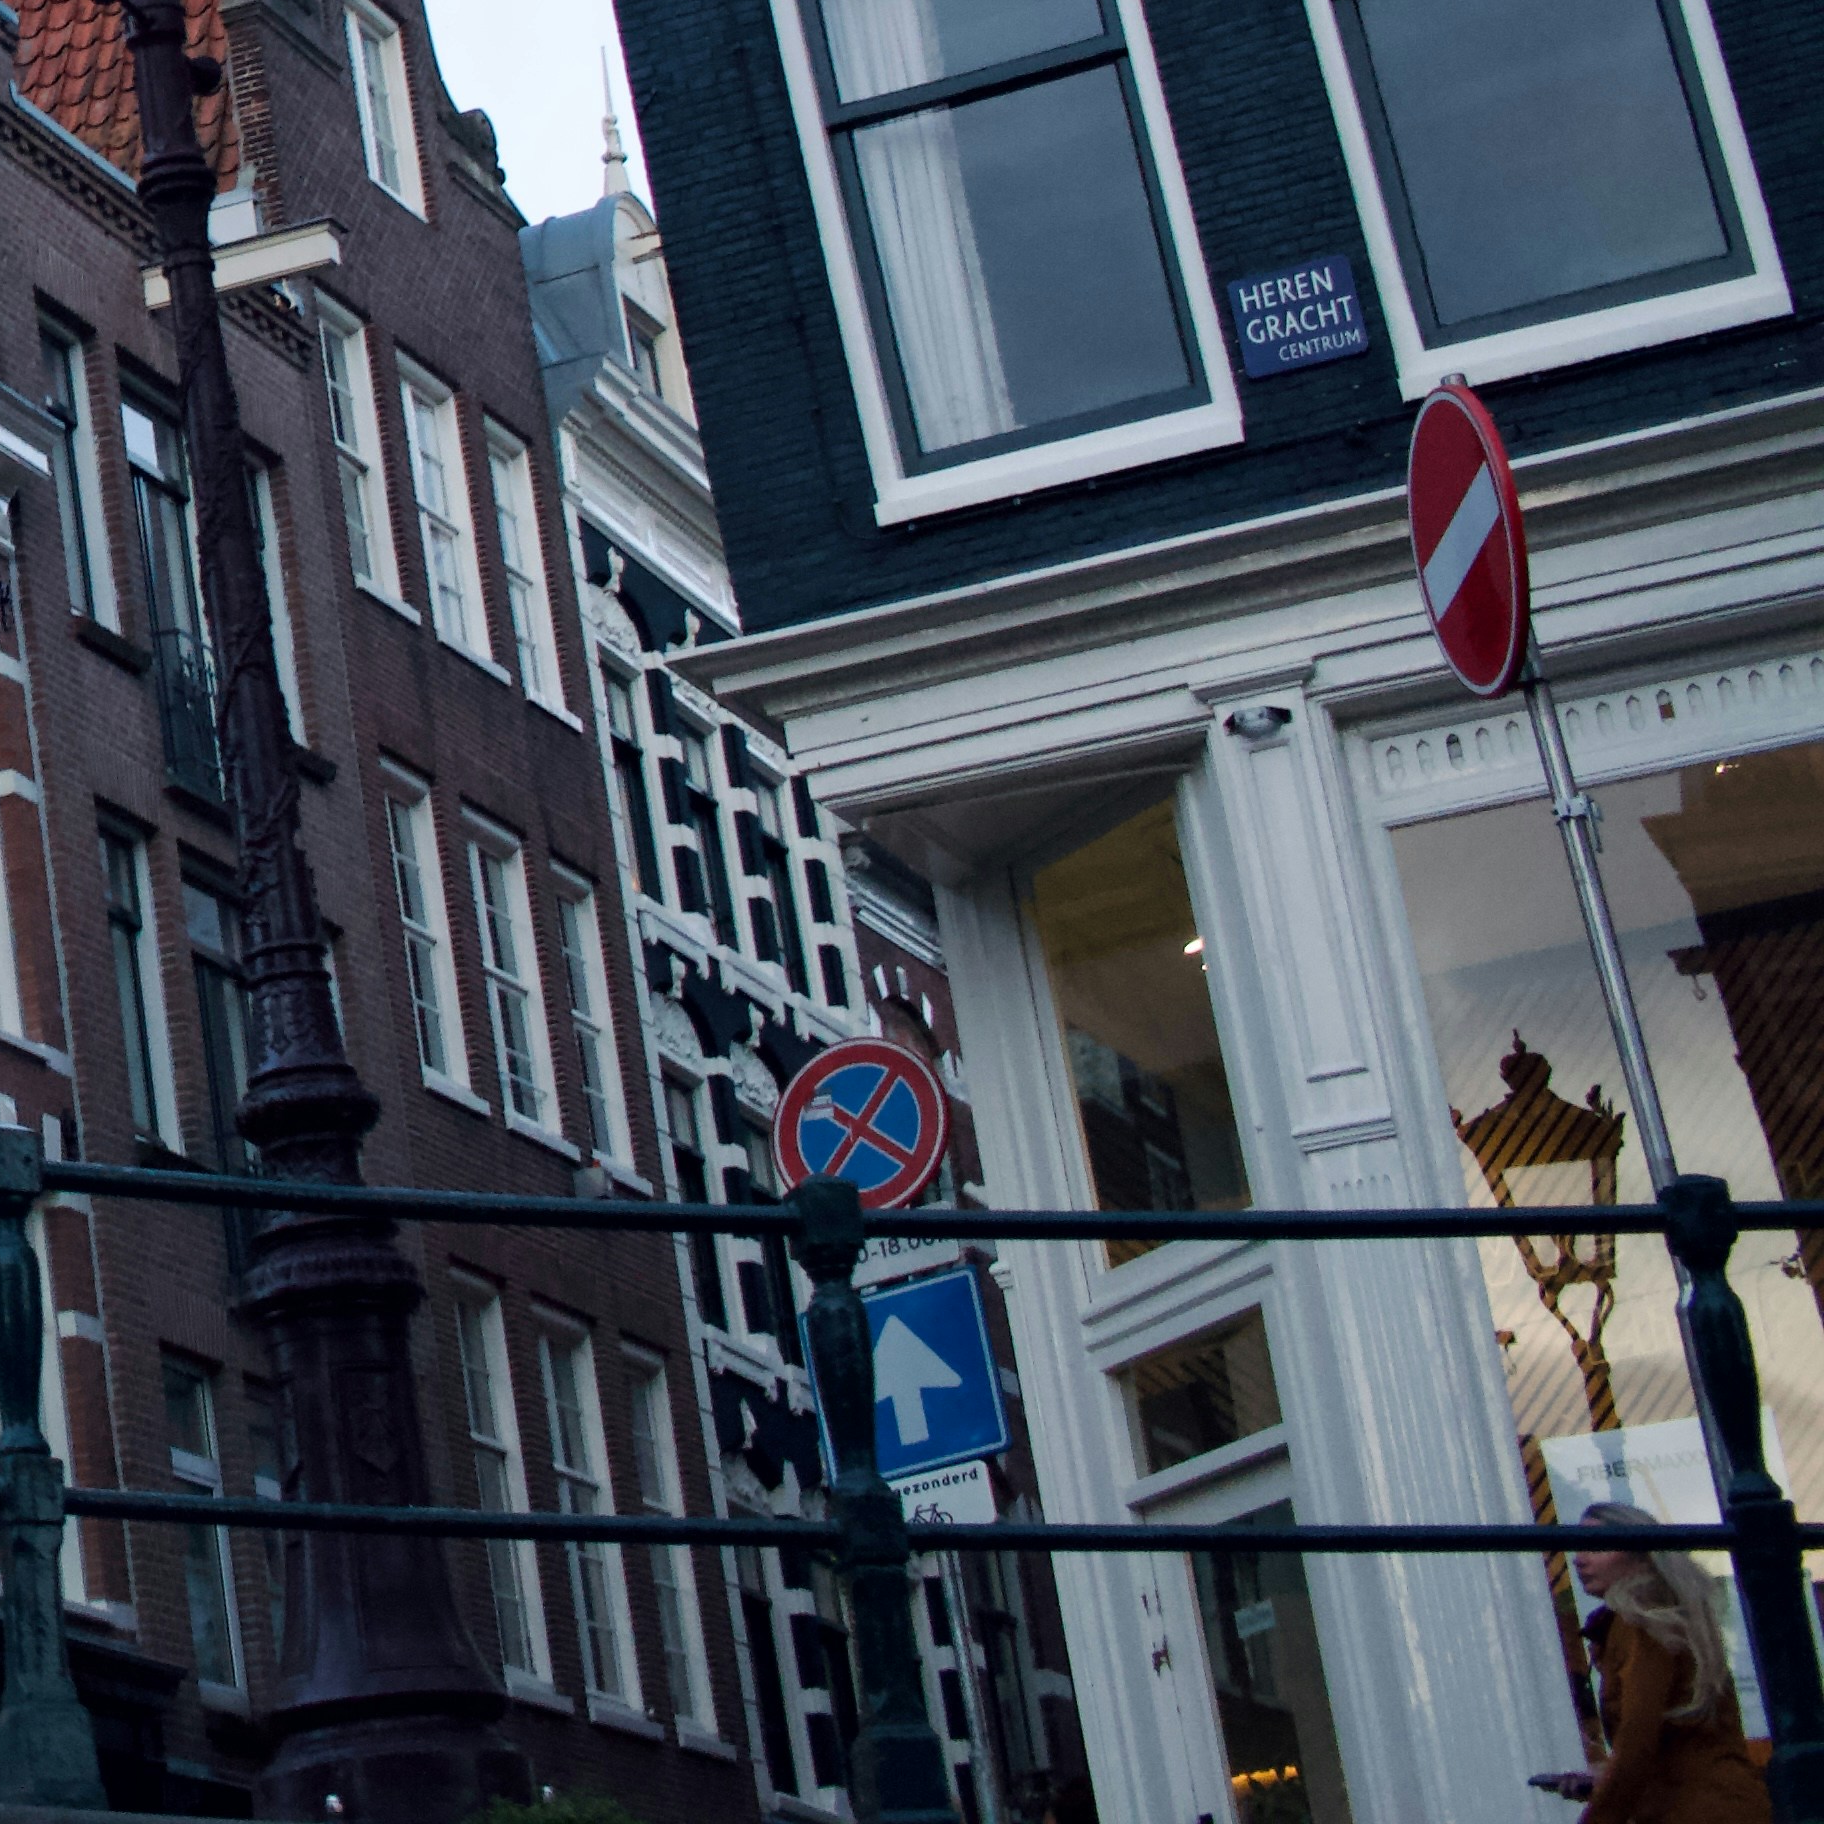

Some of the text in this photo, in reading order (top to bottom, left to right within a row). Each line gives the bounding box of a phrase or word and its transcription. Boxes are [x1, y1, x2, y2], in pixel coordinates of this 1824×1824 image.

[1239, 266, 1334, 313] HEREN
[1246, 295, 1352, 344] GRACHT
[1279, 328, 1361, 361] CENTRUM
